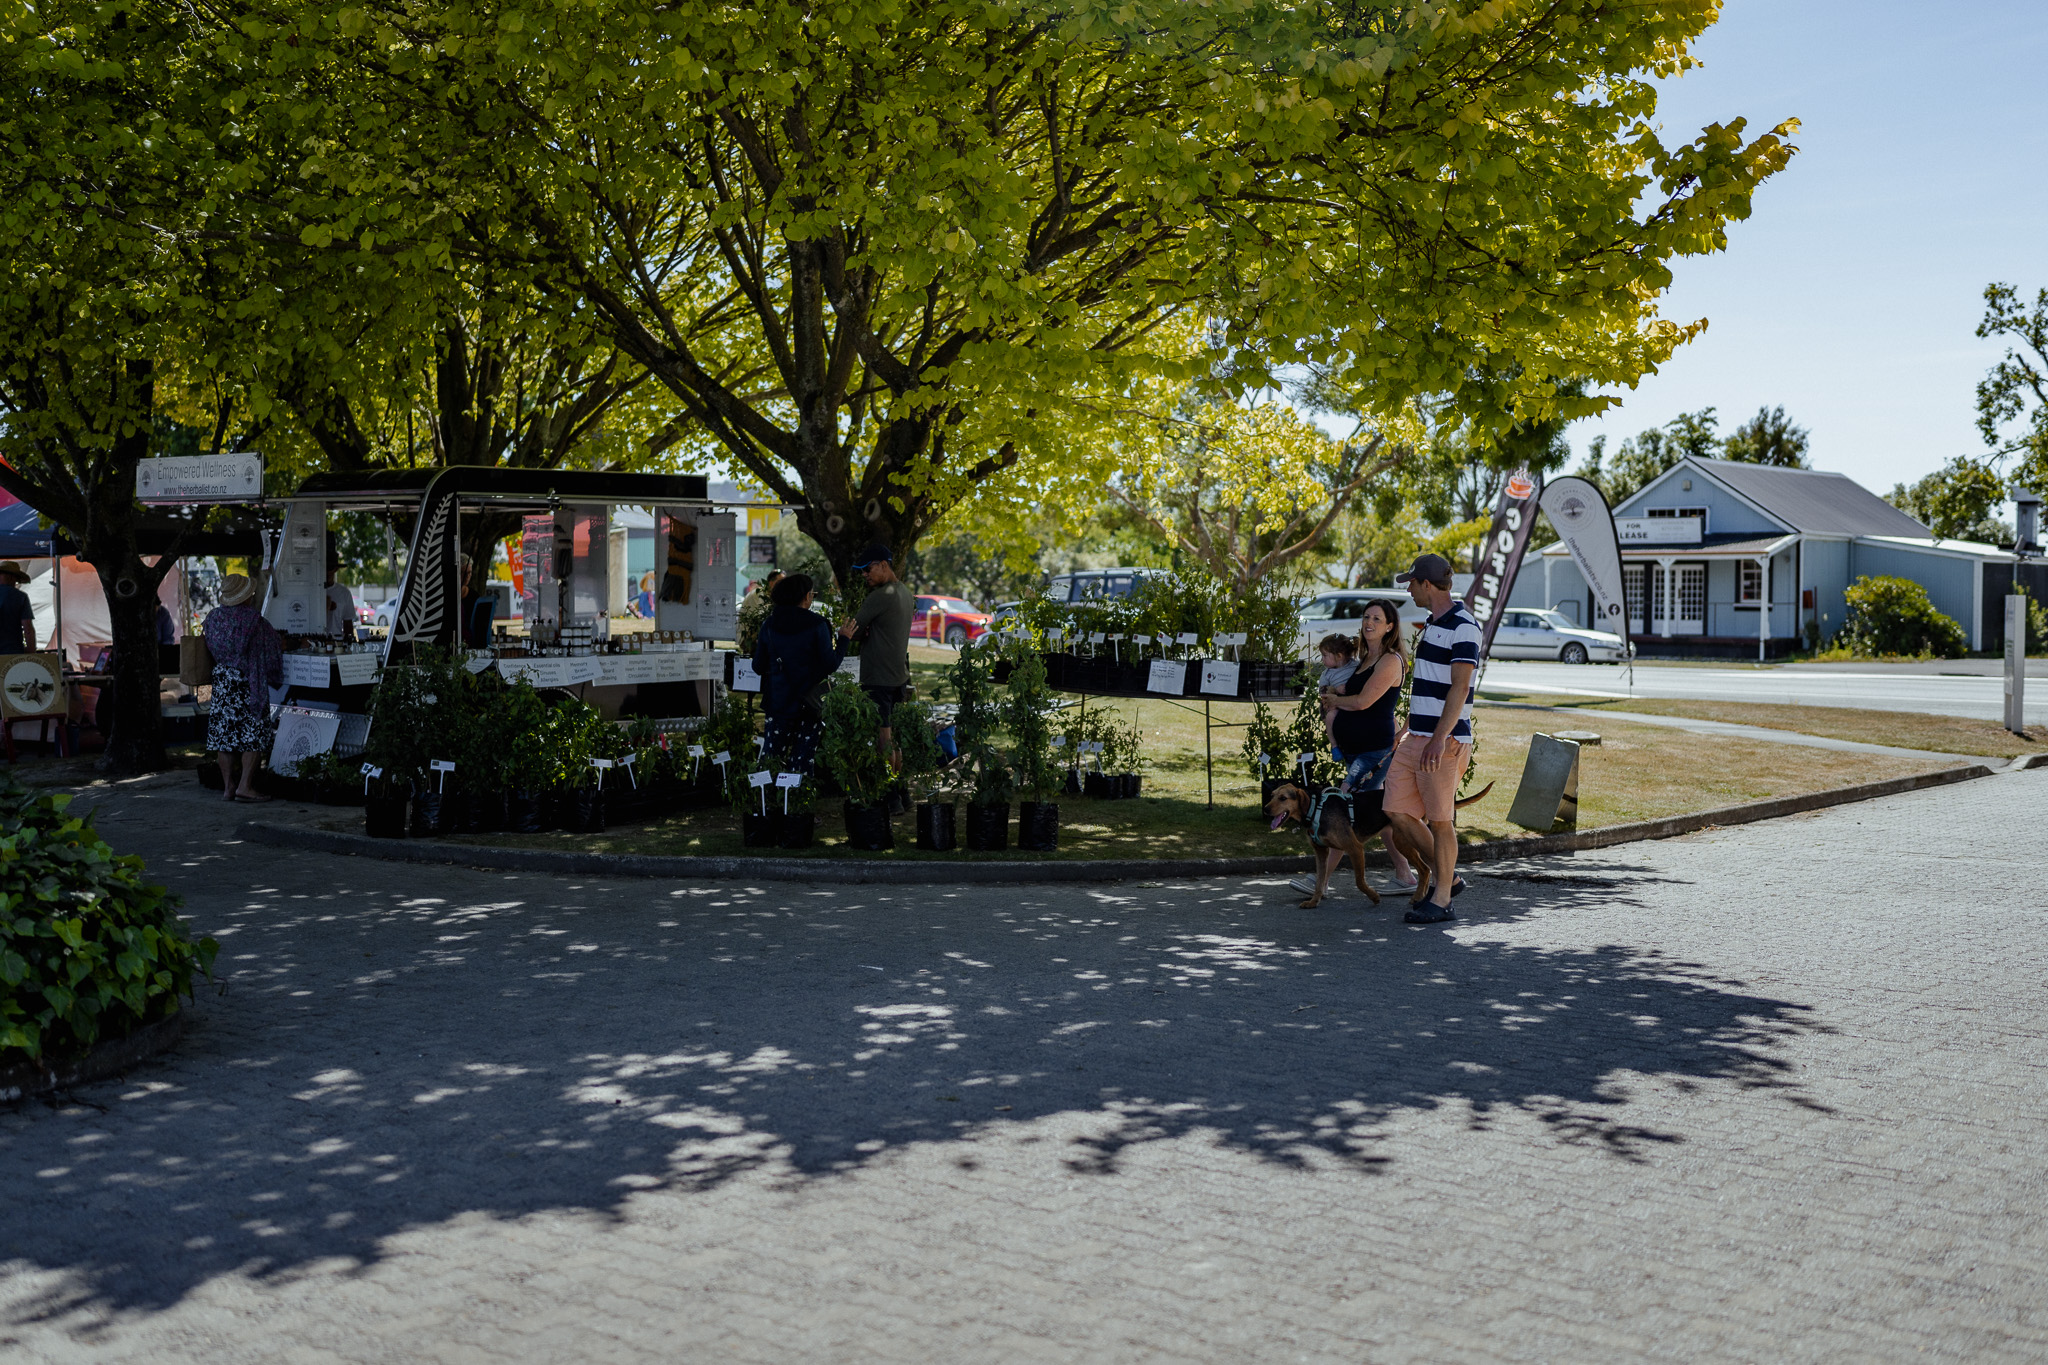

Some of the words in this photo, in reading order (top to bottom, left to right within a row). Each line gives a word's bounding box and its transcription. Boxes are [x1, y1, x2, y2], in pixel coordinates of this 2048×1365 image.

[158, 462, 200, 482] Empowered
[203, 461, 236, 478] Wellness
[1619, 531, 1649, 539] LEASE
[571, 672, 594, 680] Dementia
